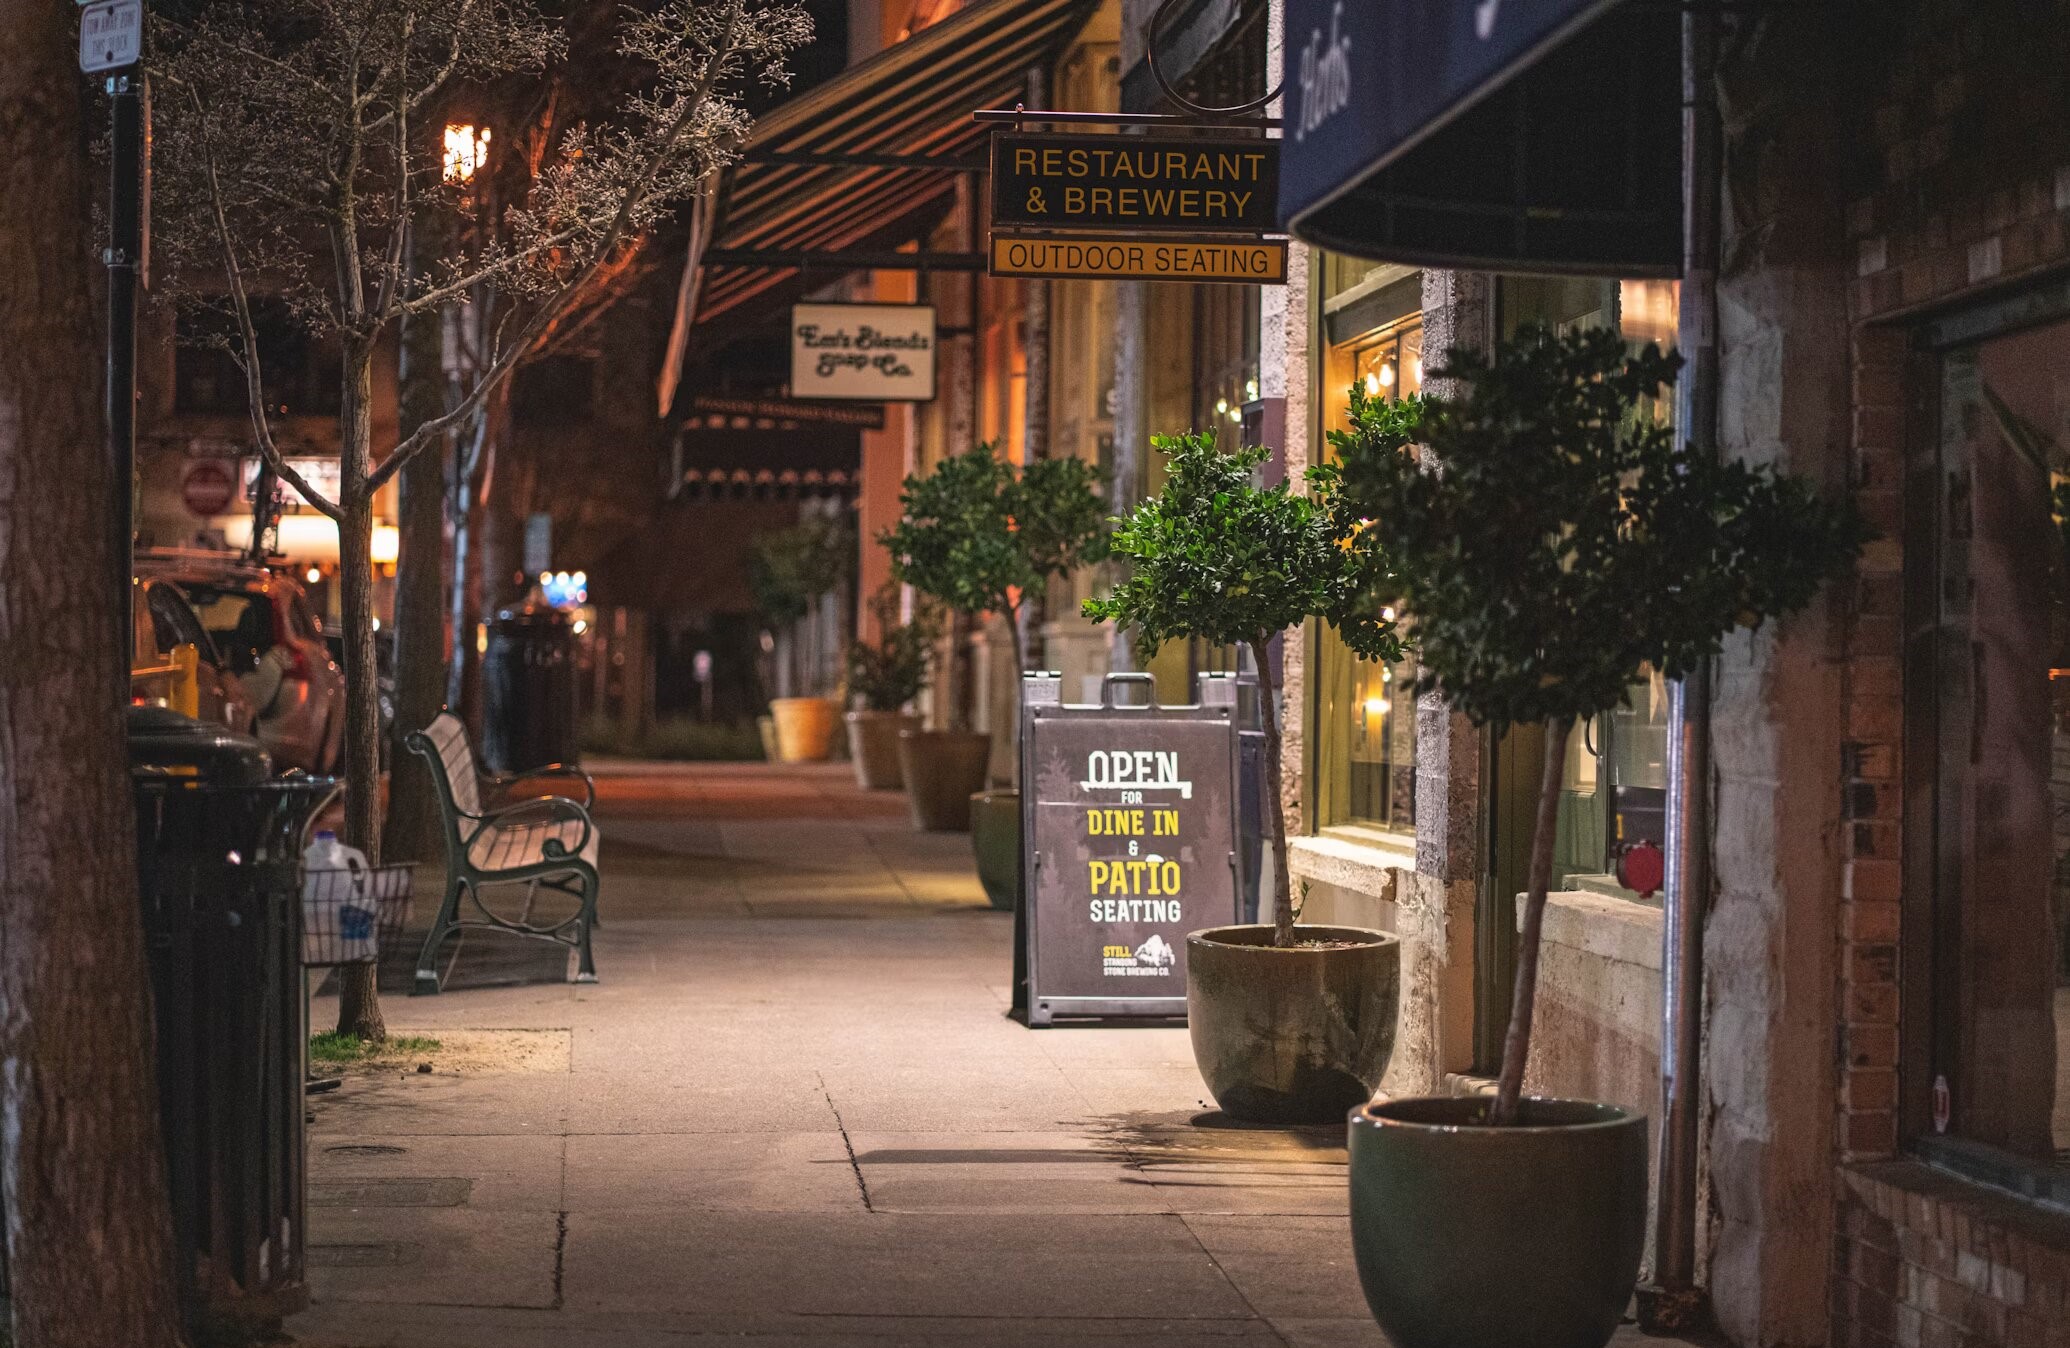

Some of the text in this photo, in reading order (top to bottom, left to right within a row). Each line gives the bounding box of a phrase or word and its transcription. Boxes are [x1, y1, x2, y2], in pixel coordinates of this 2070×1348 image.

[1015, 148, 1265, 181] RESTAURANT
[1026, 186, 1252, 218] & BREWERY
[1009, 244, 1268, 274] OUTDOOR SEATING
[1086, 750, 1182, 788] OPEN
[1121, 791, 1143, 804] FOR
[1087, 809, 1179, 836] DINE IN
[1128, 840, 1138, 856] &
[1089, 860, 1181, 895] PATIO
[1089, 899, 1181, 922] SEATING
[1103, 967, 1126, 976] STONE
[1126, 967, 1158, 976] BREWING
